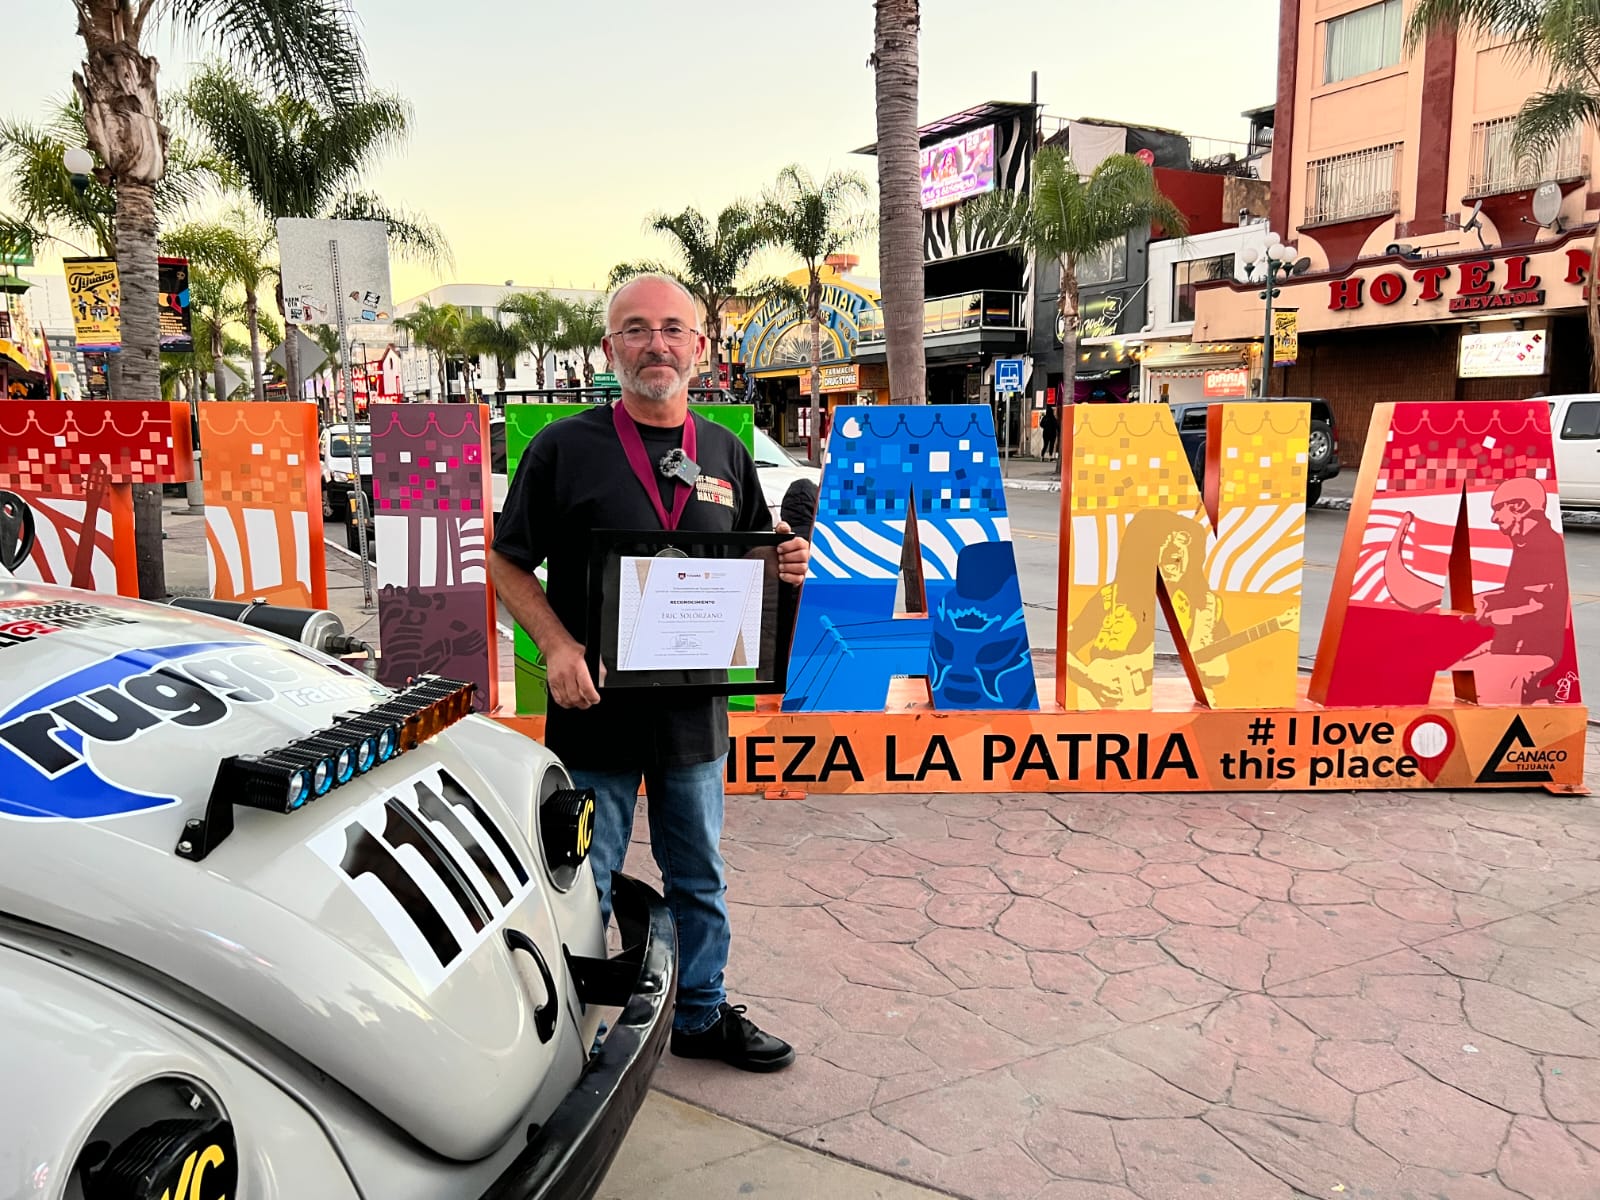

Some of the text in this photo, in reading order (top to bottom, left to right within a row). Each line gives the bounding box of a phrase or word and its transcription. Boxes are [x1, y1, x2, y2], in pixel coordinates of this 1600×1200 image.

[69, 270, 115, 293] Tijuana
[1328, 255, 1539, 311] HOTEL
[1449, 291, 1540, 311] ELEVATOR
[1207, 371, 1247, 389] BIRRIA
[1247, 715, 1395, 746] # I love
[885, 734, 962, 781] LA
[982, 732, 1199, 781] PATRIA
[1220, 748, 1419, 786] this place
[1506, 750, 1568, 763] CANACO
[1516, 763, 1556, 771] TIJUANA
[577, 799, 594, 857] KC
